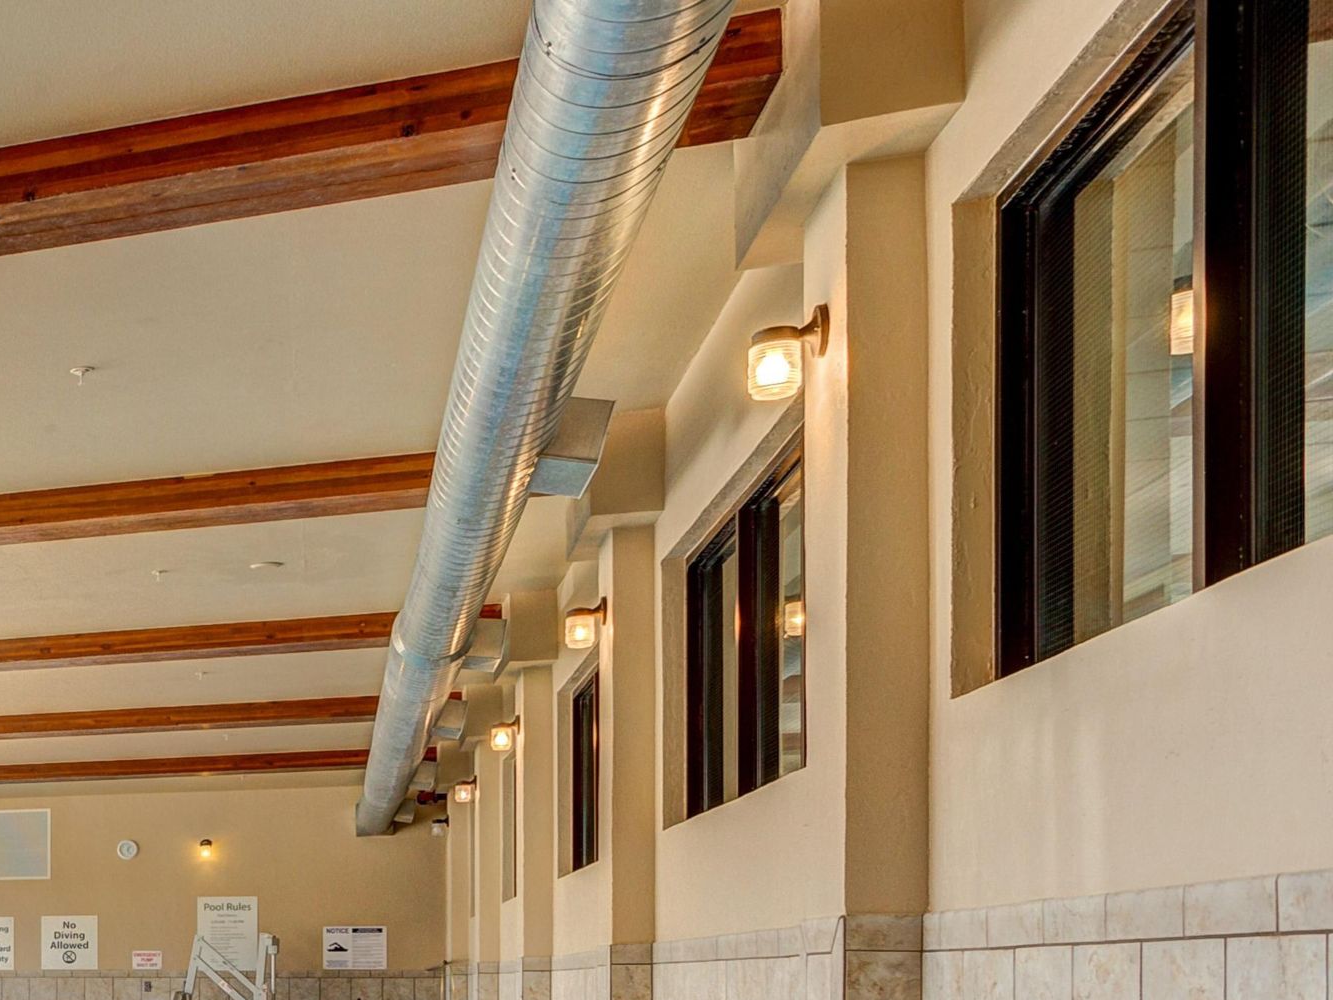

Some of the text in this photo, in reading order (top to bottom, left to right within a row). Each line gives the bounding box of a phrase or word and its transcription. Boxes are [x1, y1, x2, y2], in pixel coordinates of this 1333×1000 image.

[203, 903, 252, 911] Pool Rules
[62, 921, 76, 929] No
[53, 931, 86, 941] Diving
[50, 941, 89, 949] Allowed
